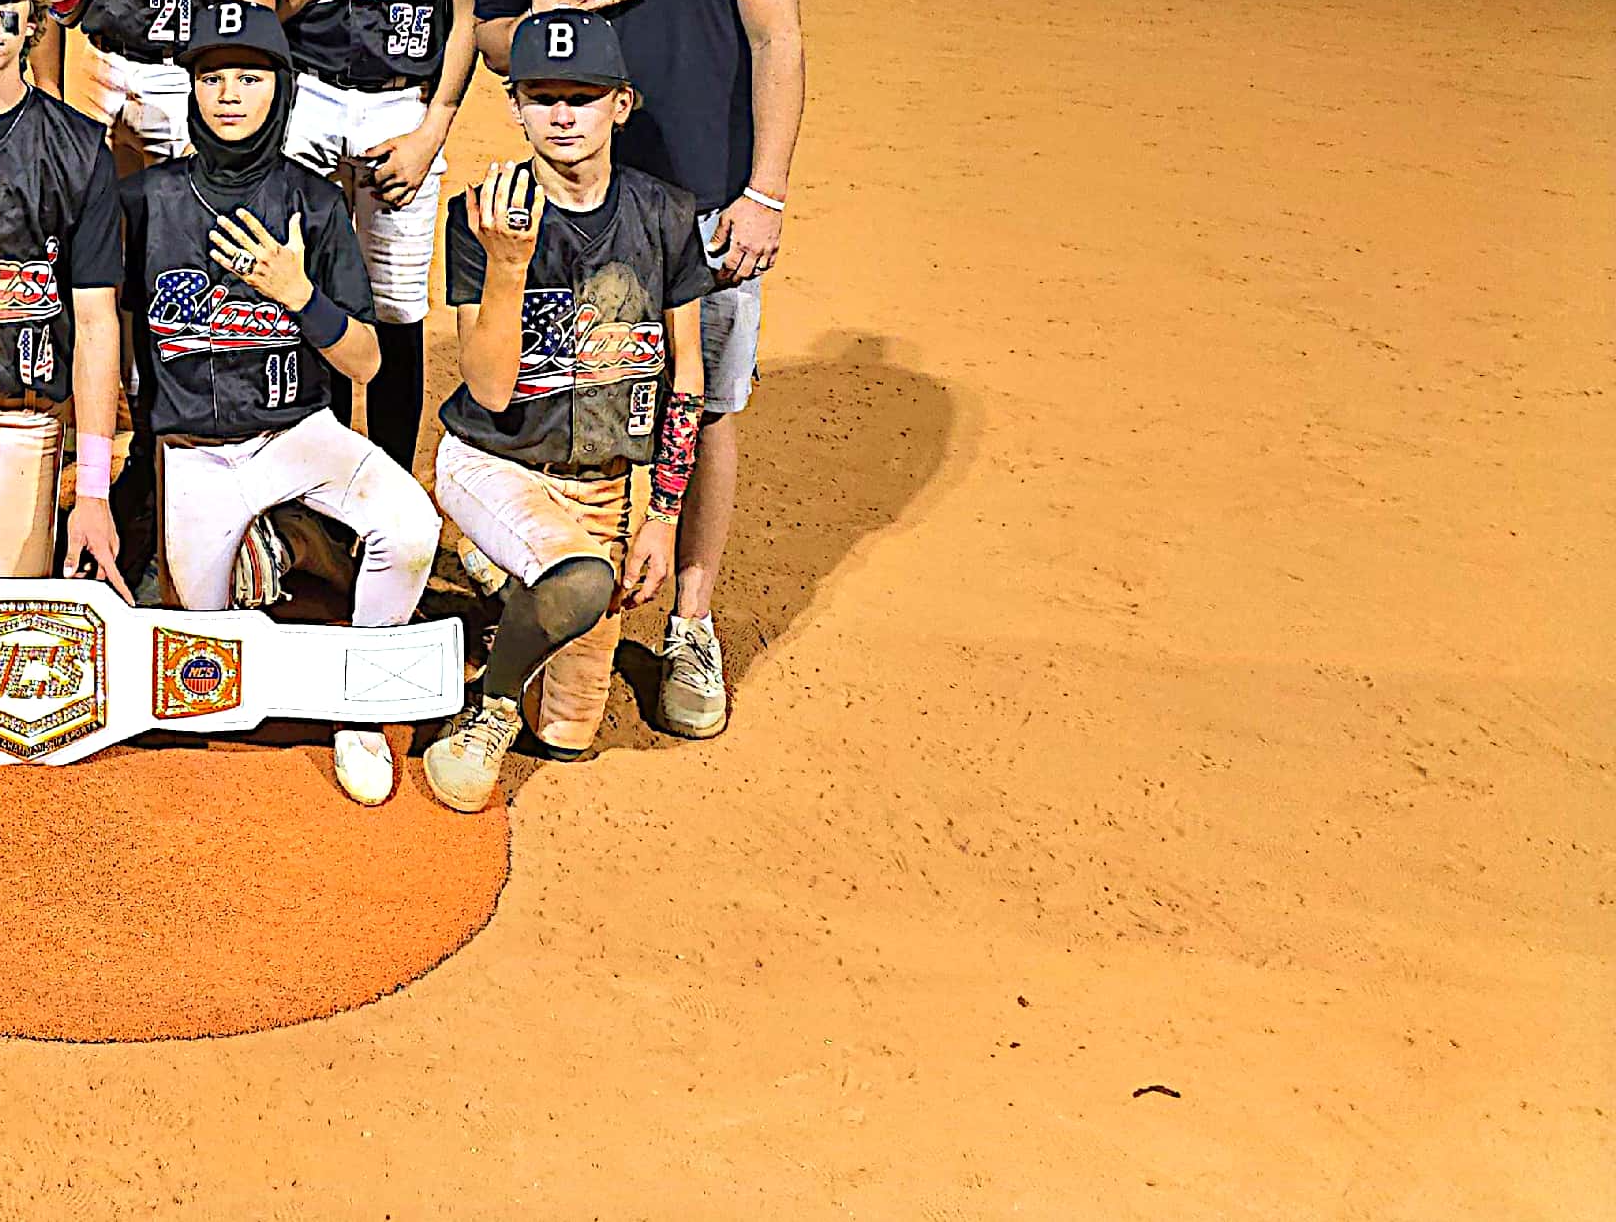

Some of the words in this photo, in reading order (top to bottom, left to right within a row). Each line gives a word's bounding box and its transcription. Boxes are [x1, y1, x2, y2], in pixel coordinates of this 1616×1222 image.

[218, 3, 243, 35] B
[387, 3, 434, 57] 35
[548, 23, 574, 57] B
[17, 324, 54, 385] 14
[266, 350, 298, 408] 11
[628, 380, 658, 436] 9
[188, 666, 215, 678] NCS
